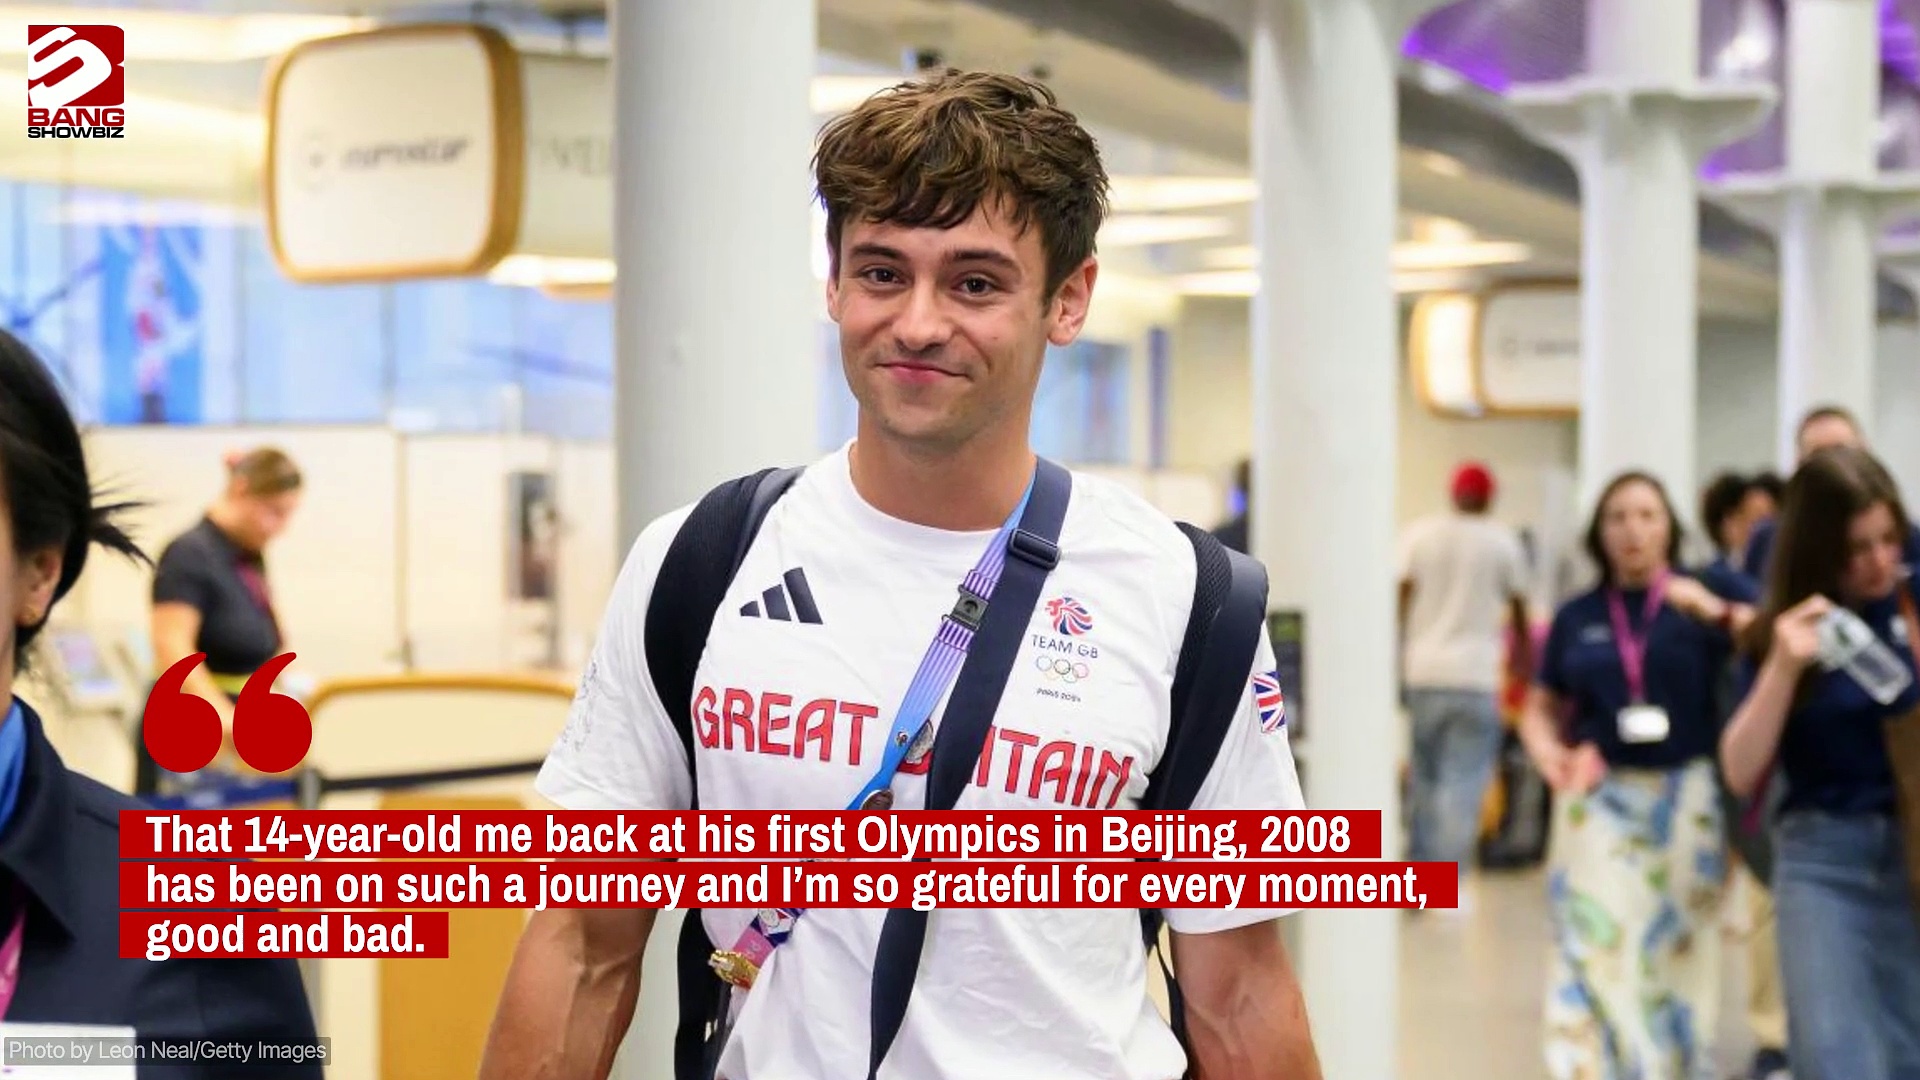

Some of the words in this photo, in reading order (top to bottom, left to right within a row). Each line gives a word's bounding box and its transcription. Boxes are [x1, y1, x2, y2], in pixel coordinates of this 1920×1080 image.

[1031, 634, 1073, 654] TEAM
[1077, 644, 1098, 658] GB
[692, 686, 879, 766] GREAT
[896, 722, 1134, 811] ITAIN
